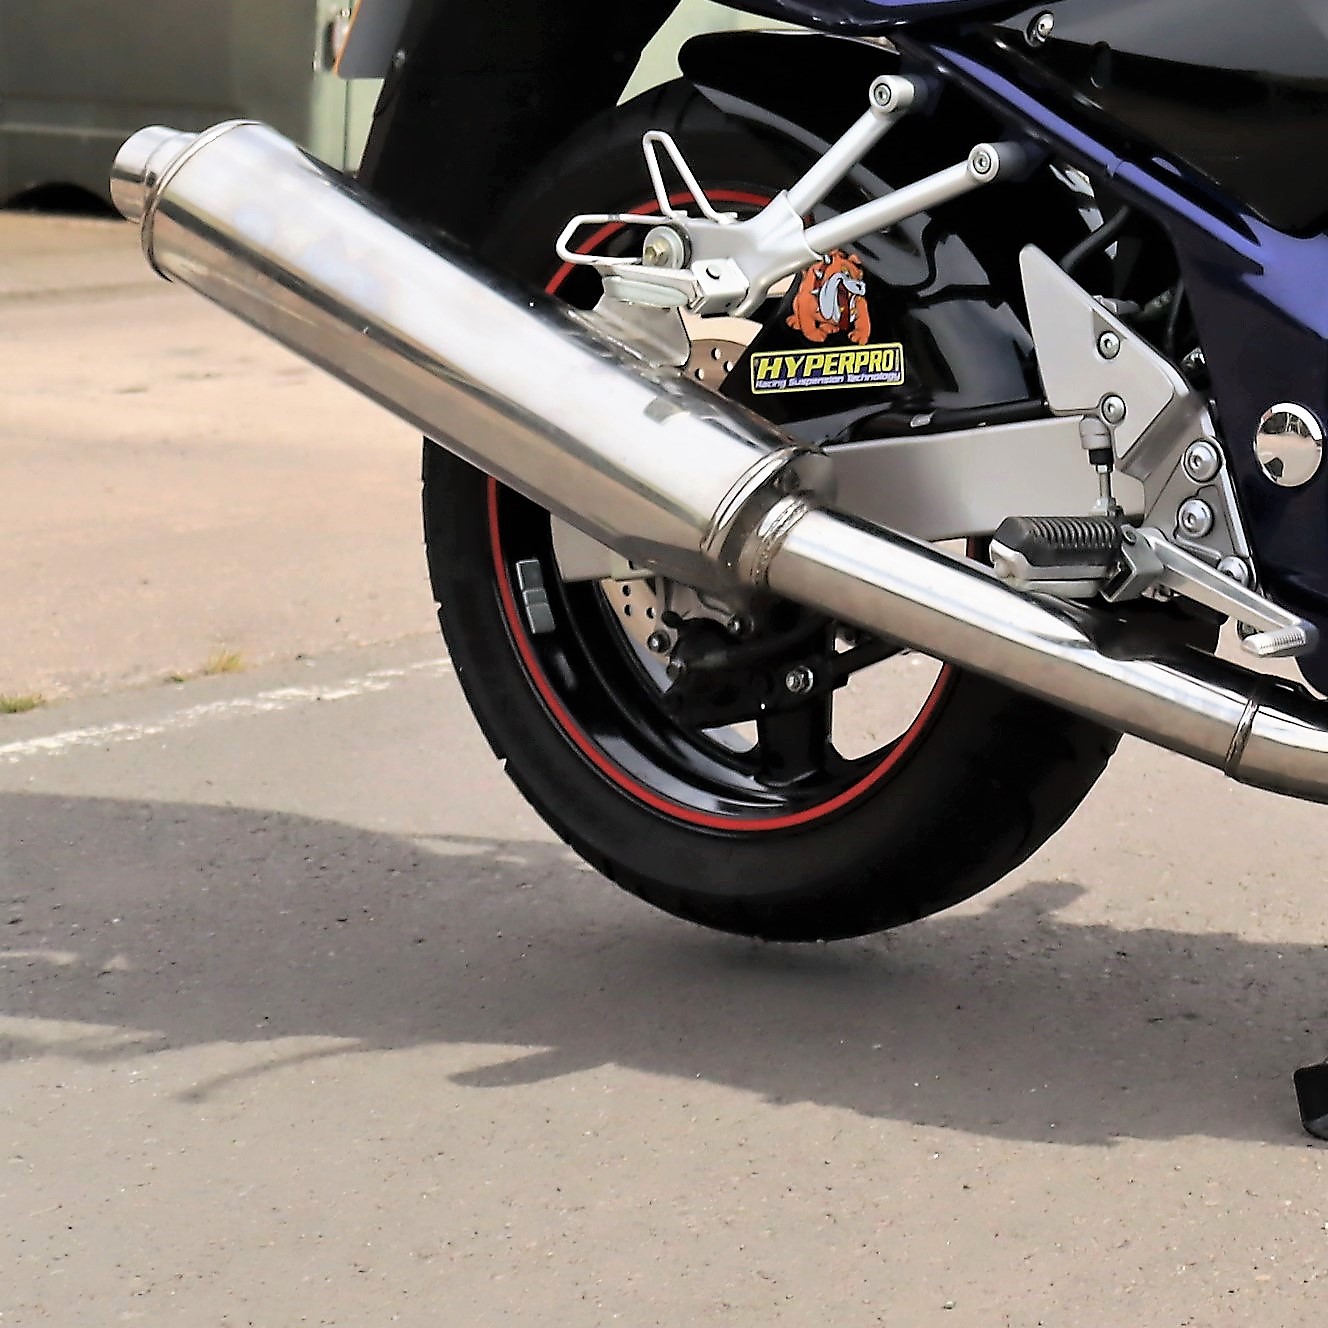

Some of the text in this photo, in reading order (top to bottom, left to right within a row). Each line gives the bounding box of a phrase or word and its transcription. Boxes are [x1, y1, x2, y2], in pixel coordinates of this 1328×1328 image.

[756, 349, 895, 380] HYPERPRO
[755, 371, 901, 390] Racing Suspension Technology
